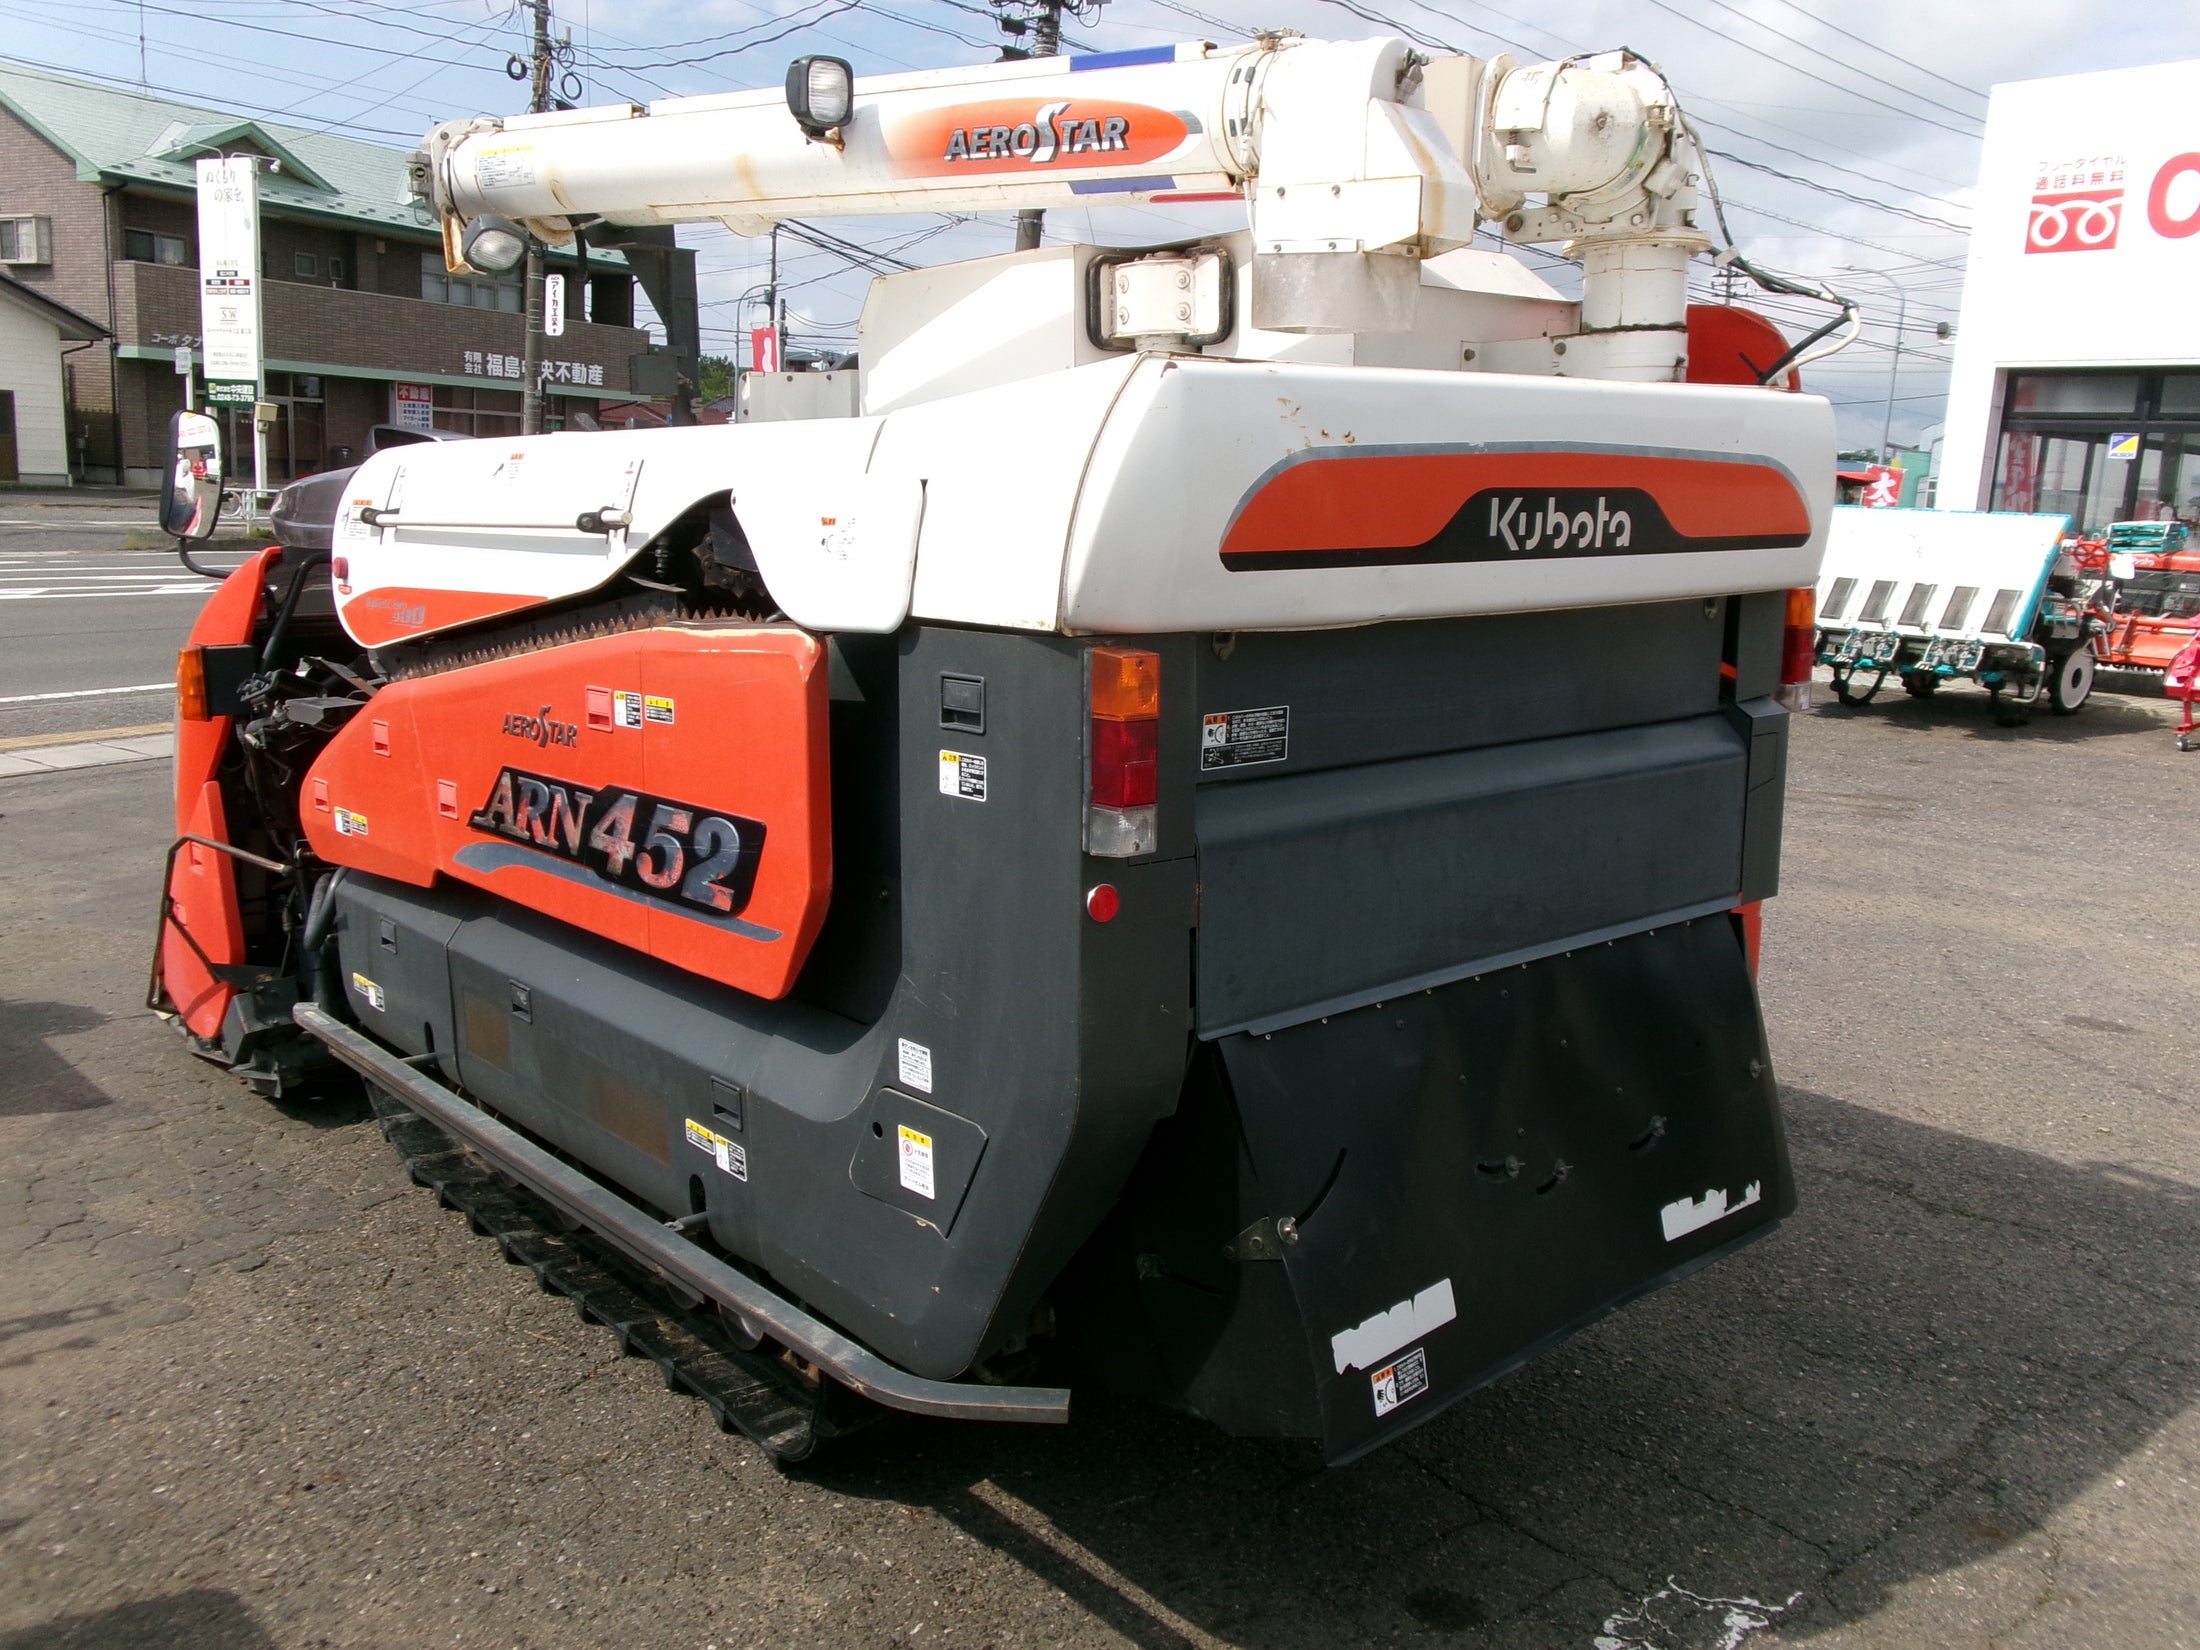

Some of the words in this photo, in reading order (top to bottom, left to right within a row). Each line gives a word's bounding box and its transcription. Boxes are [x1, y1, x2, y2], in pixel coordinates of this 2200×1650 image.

[944, 101, 1130, 162] AEROSTAR
[486, 353, 604, 386] 福島央不動産
[1489, 496, 1631, 550] Kubota
[502, 705, 578, 747] AEROSTAR
